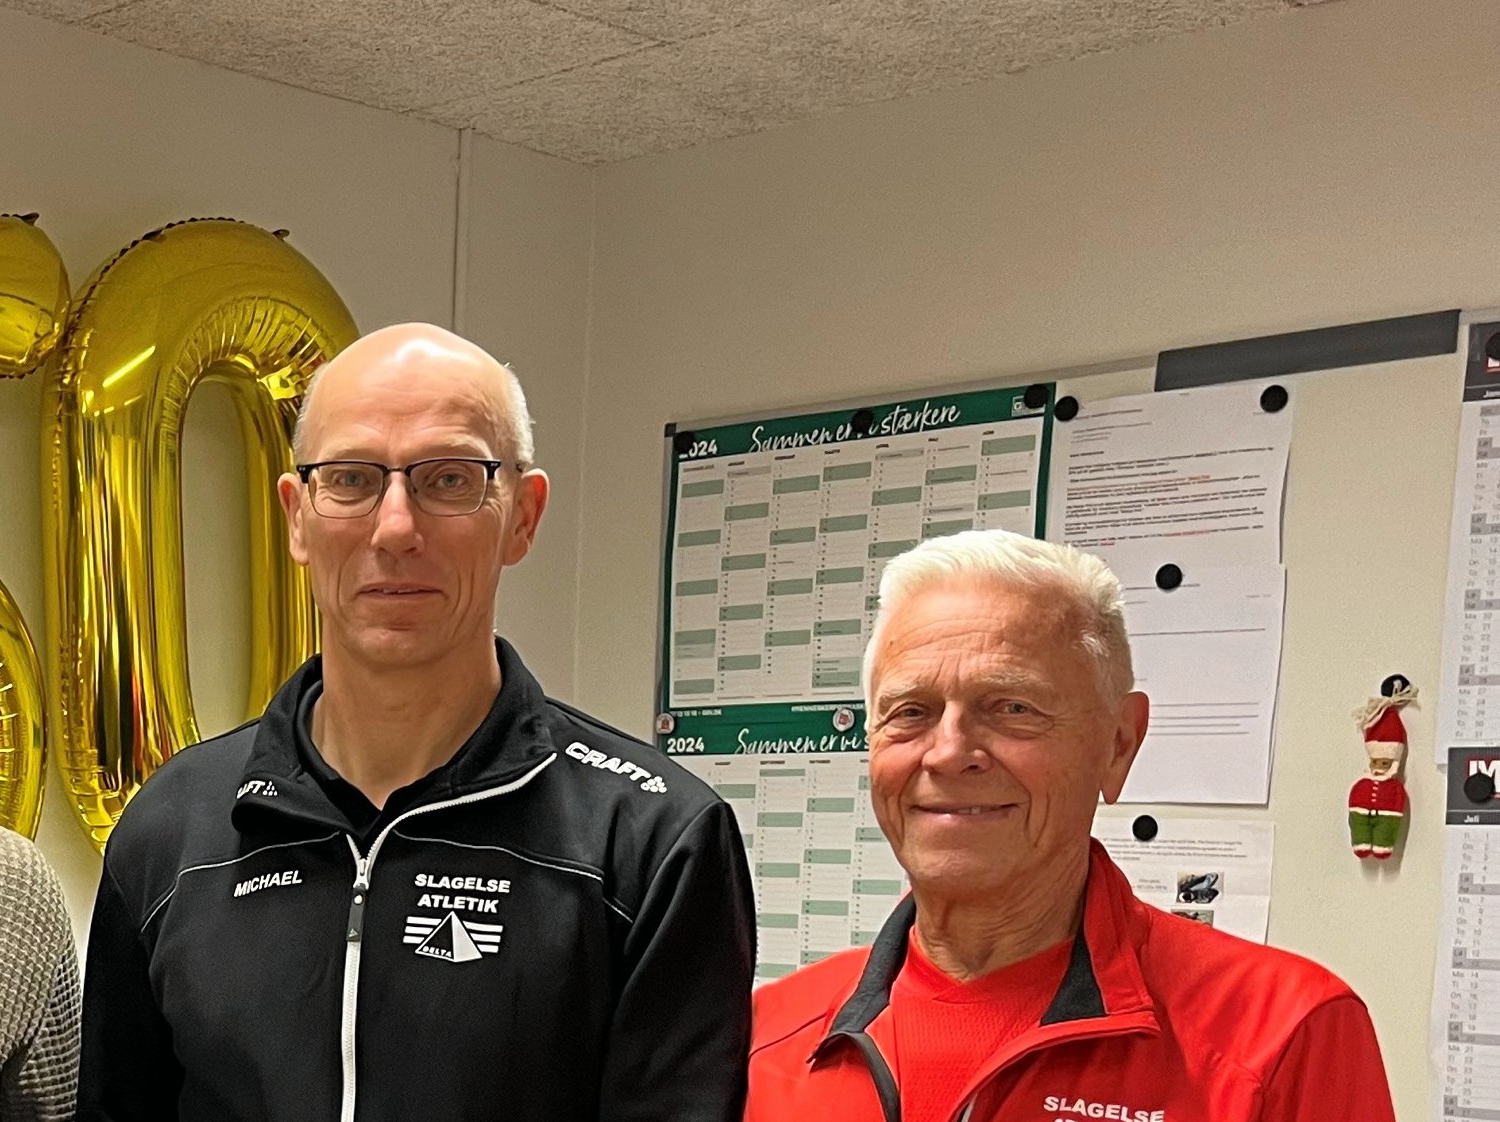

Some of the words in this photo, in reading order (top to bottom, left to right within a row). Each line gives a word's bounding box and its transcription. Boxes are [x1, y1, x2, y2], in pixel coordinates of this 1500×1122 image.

[678, 439, 718, 459] 024
[667, 737, 705, 753] 2024
[820, 734, 838, 752] er
[840, 732, 862, 751] vi
[565, 741, 652, 781] CRAFT
[1464, 815, 1480, 823] Juli
[233, 870, 303, 897] MICHAEL
[414, 873, 511, 893] SLAGELSE
[417, 894, 499, 913] ATLETIK
[422, 945, 452, 958] DELTA
